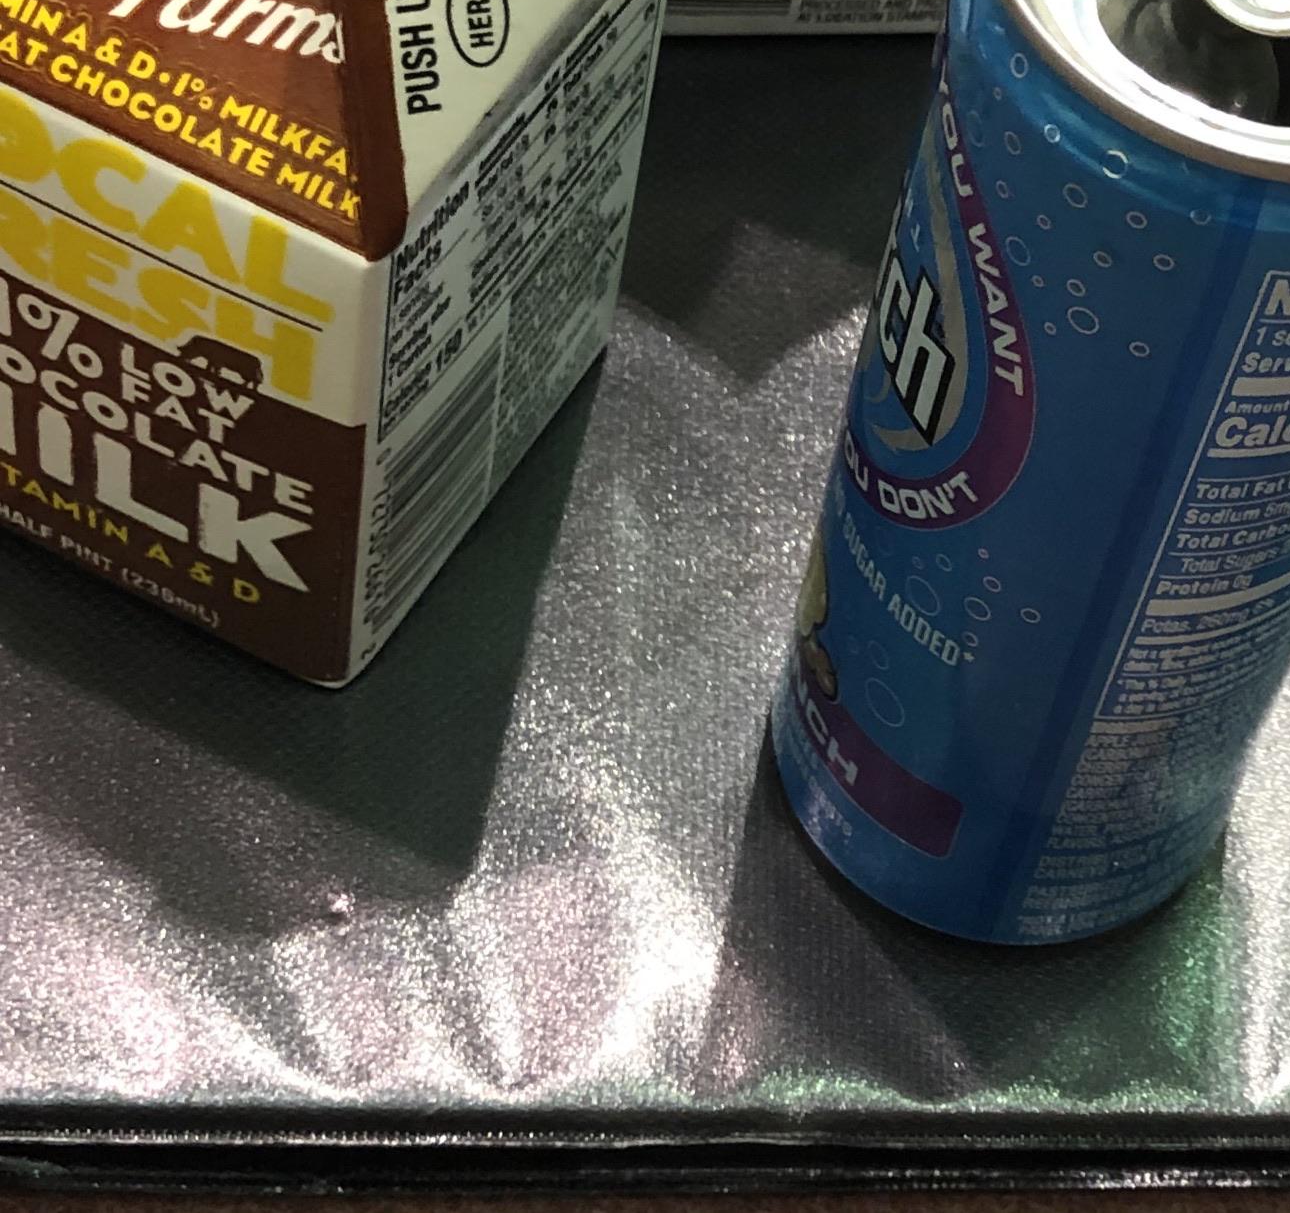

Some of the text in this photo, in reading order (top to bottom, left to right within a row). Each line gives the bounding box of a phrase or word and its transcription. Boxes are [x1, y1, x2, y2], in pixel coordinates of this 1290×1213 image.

[63, 23, 90, 53] A
[94, 36, 123, 67] &
[127, 50, 157, 82] D
[219, 93, 360, 182] MILKFA
[399, 23, 442, 115] PUSH
[50, 54, 361, 220] CHOCOLATE MILK
[0, 92, 336, 324] OCAL
[396, 181, 469, 277] Nutrition
[0, 193, 318, 402] RESH
[968, 222, 1024, 396] WANT
[121, 342, 254, 420] LOW
[122, 373, 236, 444] FAT
[1224, 400, 1290, 414] Amount
[0, 344, 313, 514] OCOLATE
[843, 429, 980, 520] OU DON'T
[0, 462, 260, 604] TAMIN A & D
[1183, 507, 1261, 525] Sodium
[1196, 478, 1286, 500] Total Fat
[61, 535, 112, 572] PINT
[843, 512, 887, 601] SUGAR
[1155, 578, 1230, 596] Protein
